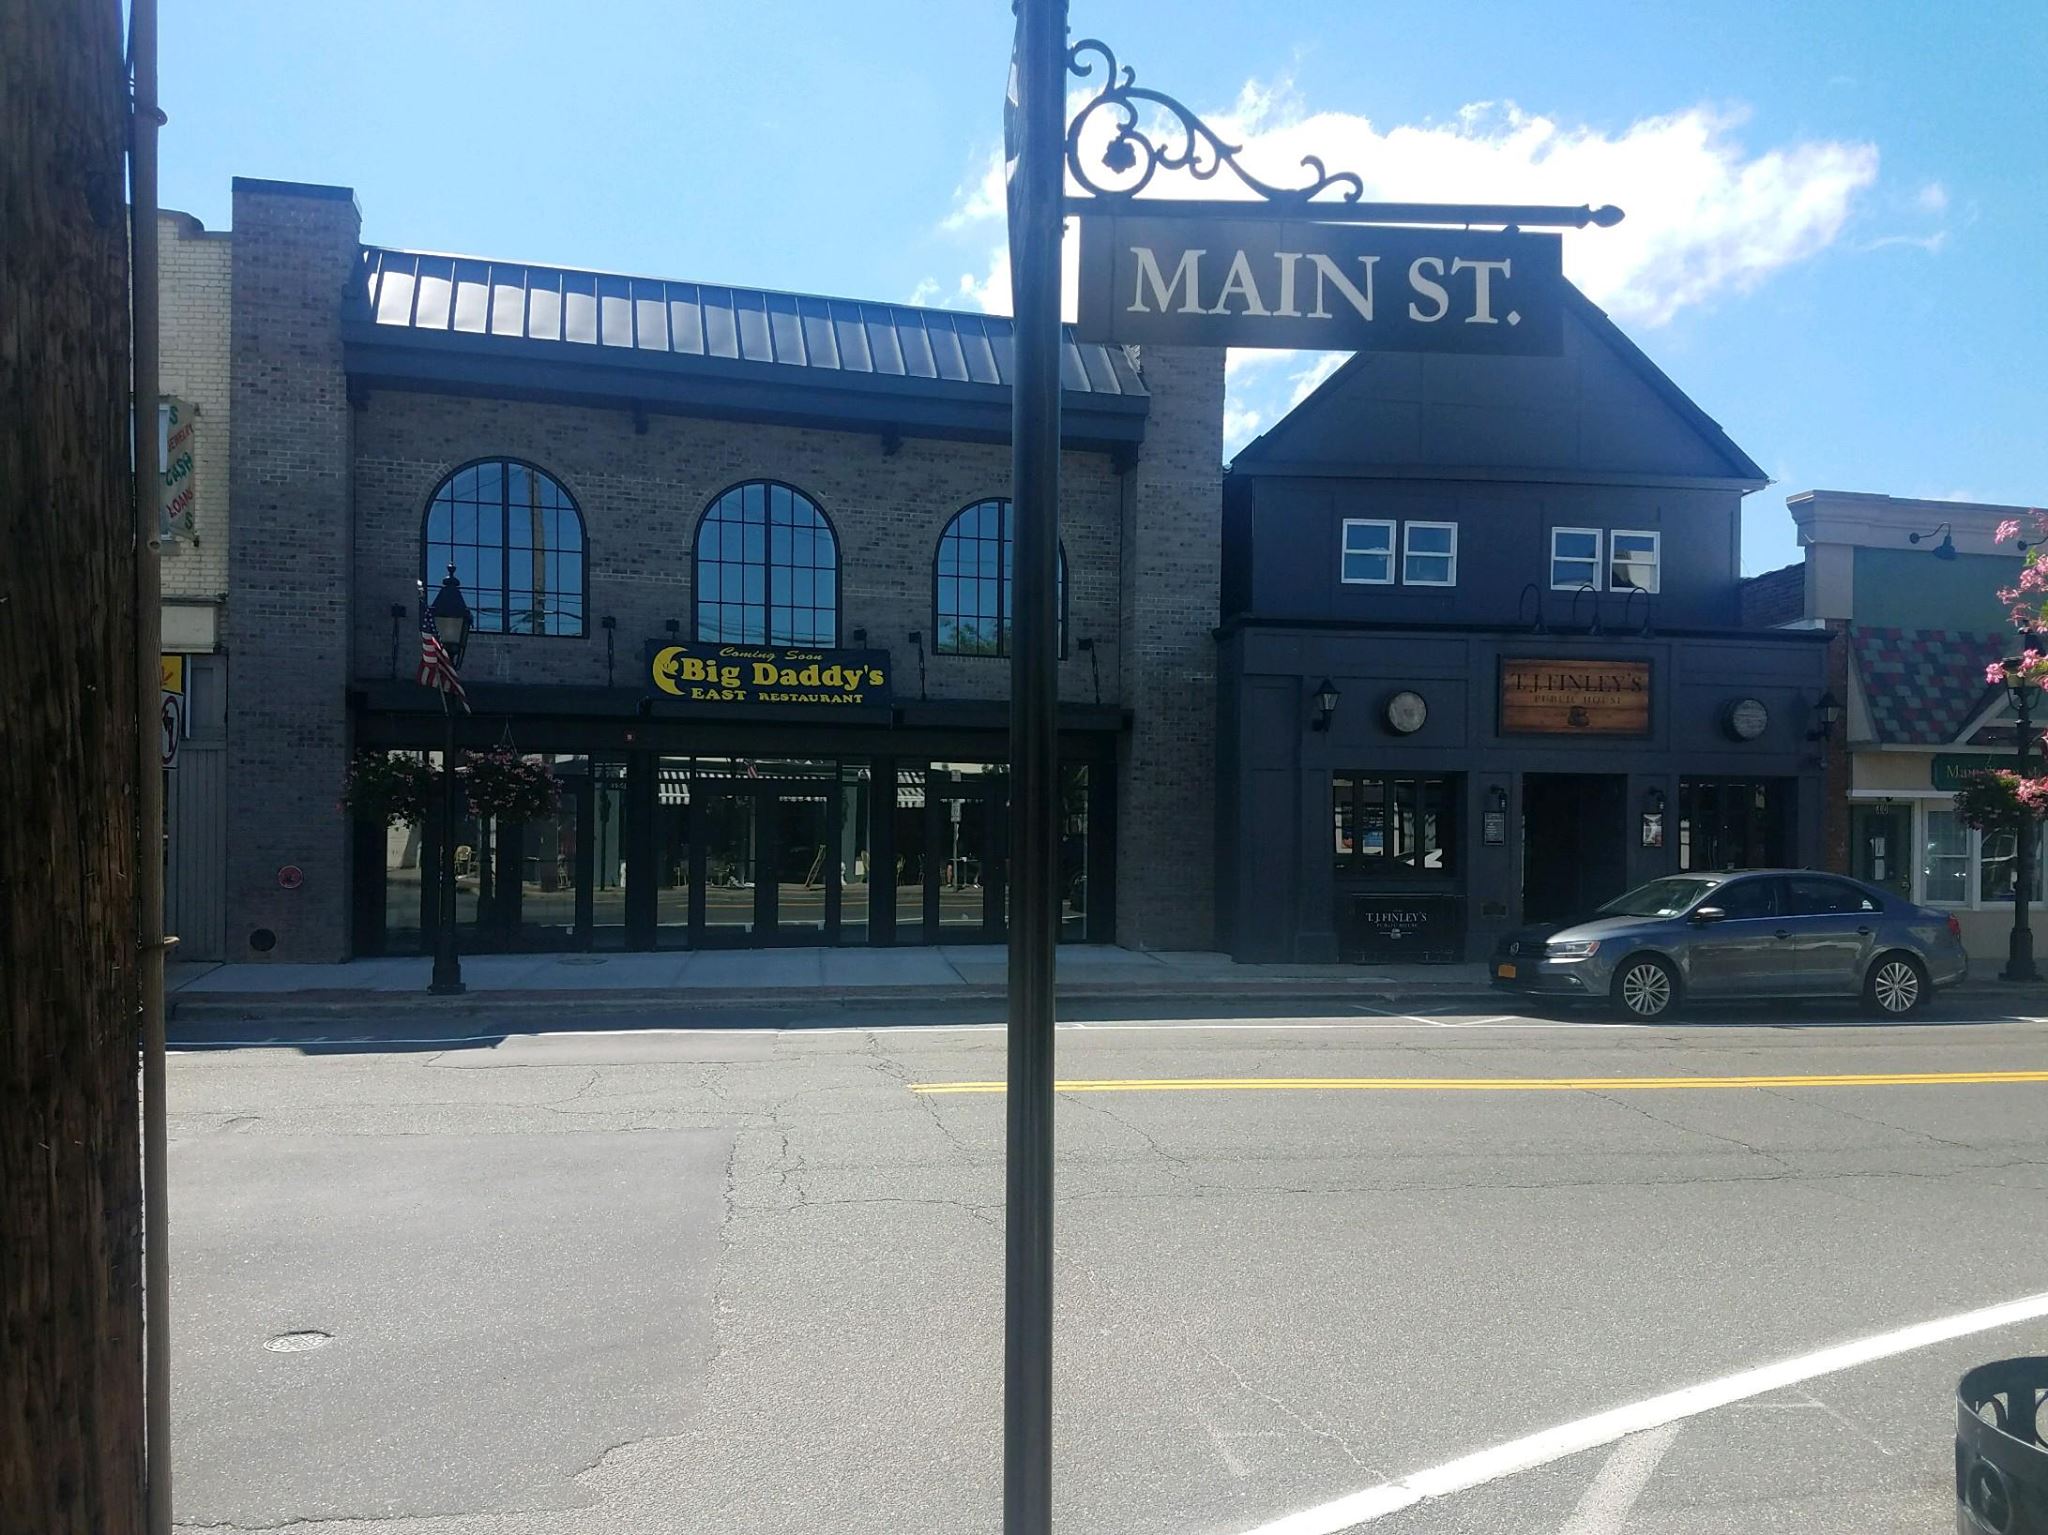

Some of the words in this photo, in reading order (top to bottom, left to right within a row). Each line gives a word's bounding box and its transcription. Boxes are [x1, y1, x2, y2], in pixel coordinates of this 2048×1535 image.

[1126, 246, 1381, 321] MAIN
[1408, 256, 1522, 327] ST.
[166, 451, 193, 486] CASH
[719, 646, 776, 661] Coming
[784, 649, 823, 661] Soon
[680, 657, 741, 688] Big
[751, 662, 885, 691] Daddy's
[690, 687, 747, 700] EAST
[759, 692, 863, 704] RESTAURANT
